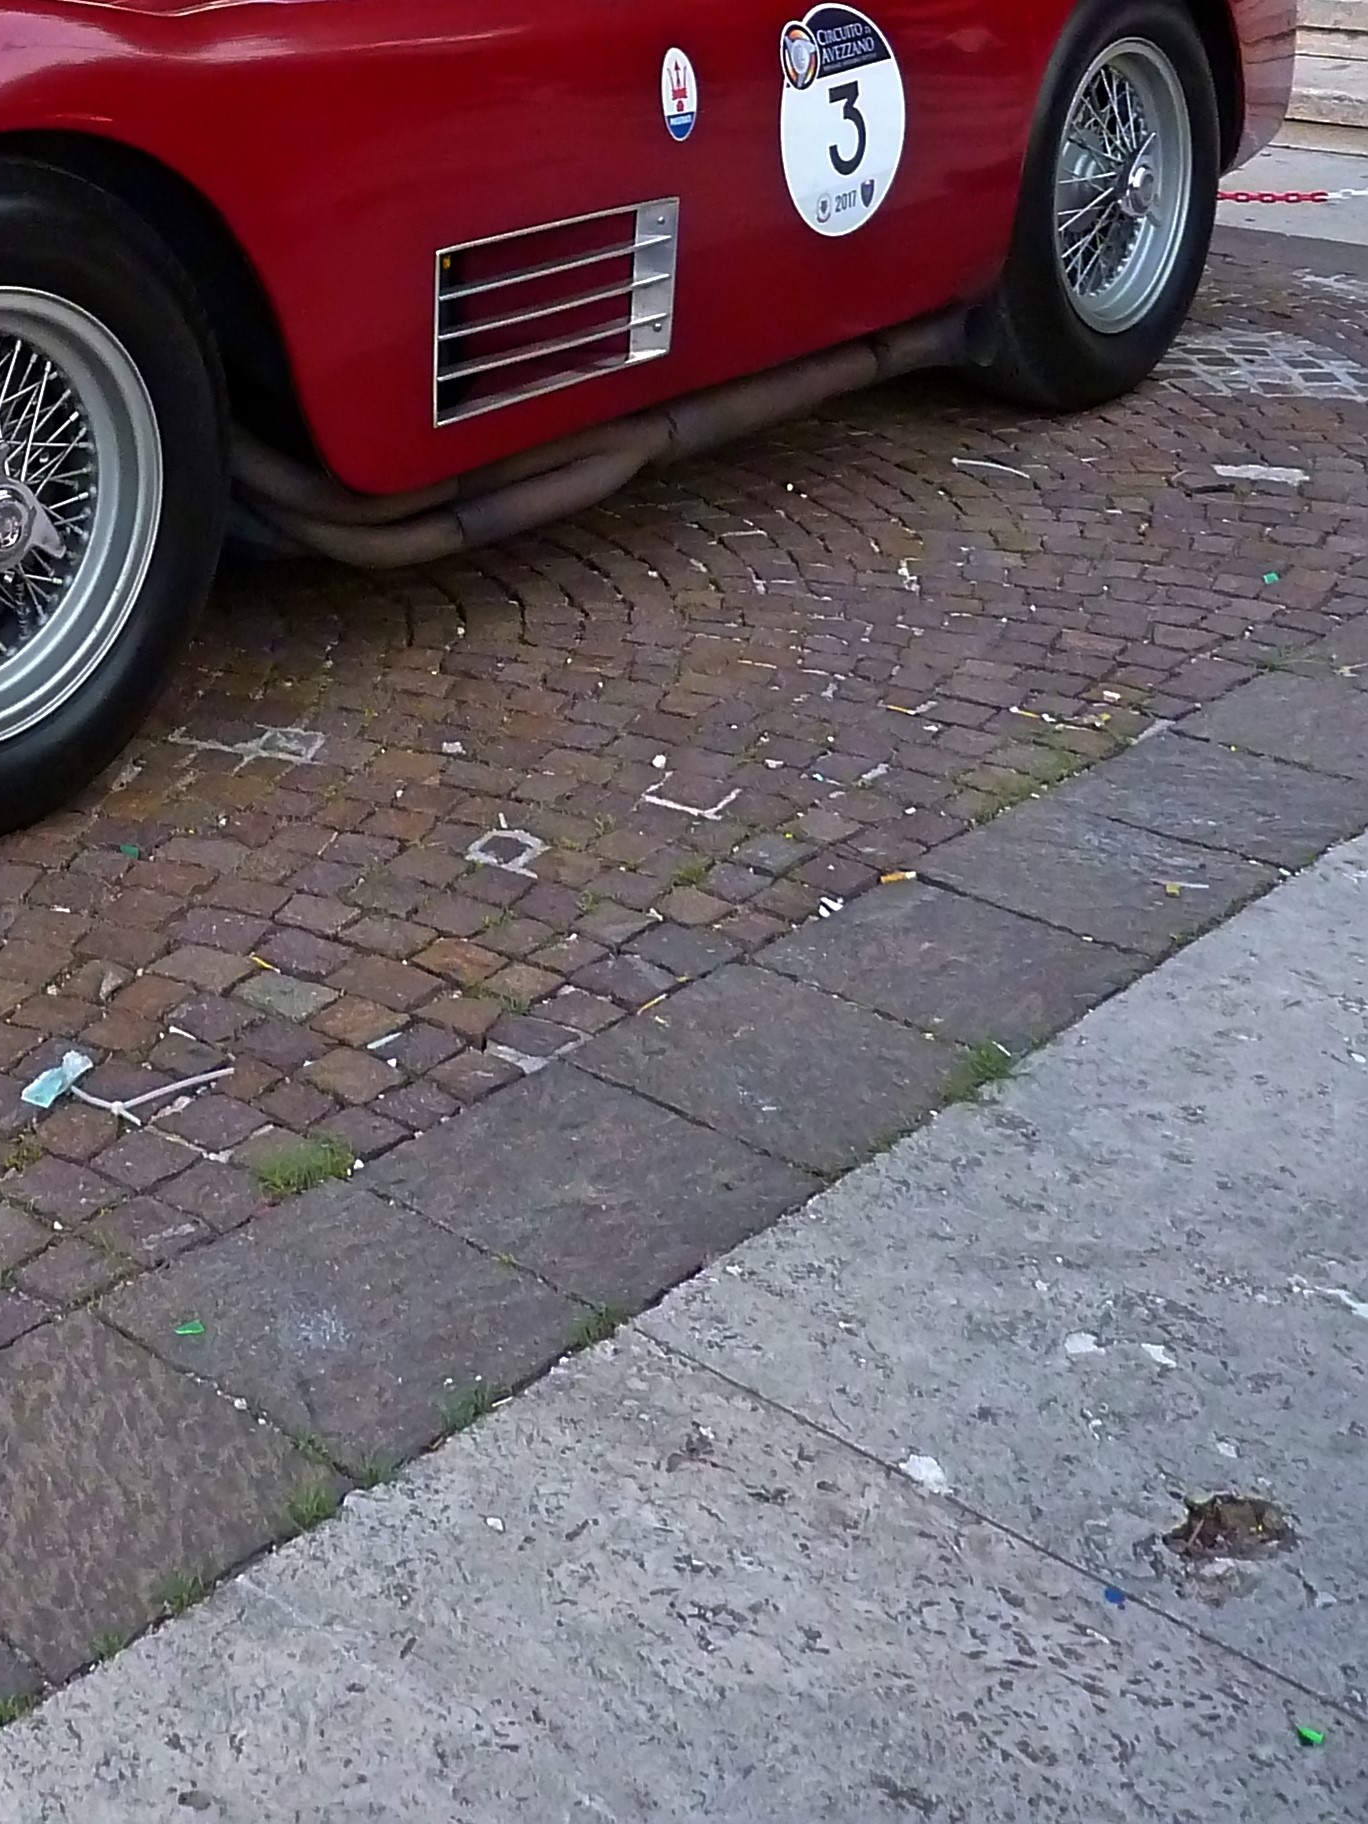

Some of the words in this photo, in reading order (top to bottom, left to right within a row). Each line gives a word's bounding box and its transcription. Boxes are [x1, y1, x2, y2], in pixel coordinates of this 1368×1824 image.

[816, 22, 863, 46] CIRCUITO
[822, 36, 875, 65] AVEZZANO
[828, 80, 867, 176] 3
[834, 189, 858, 214] 2017
